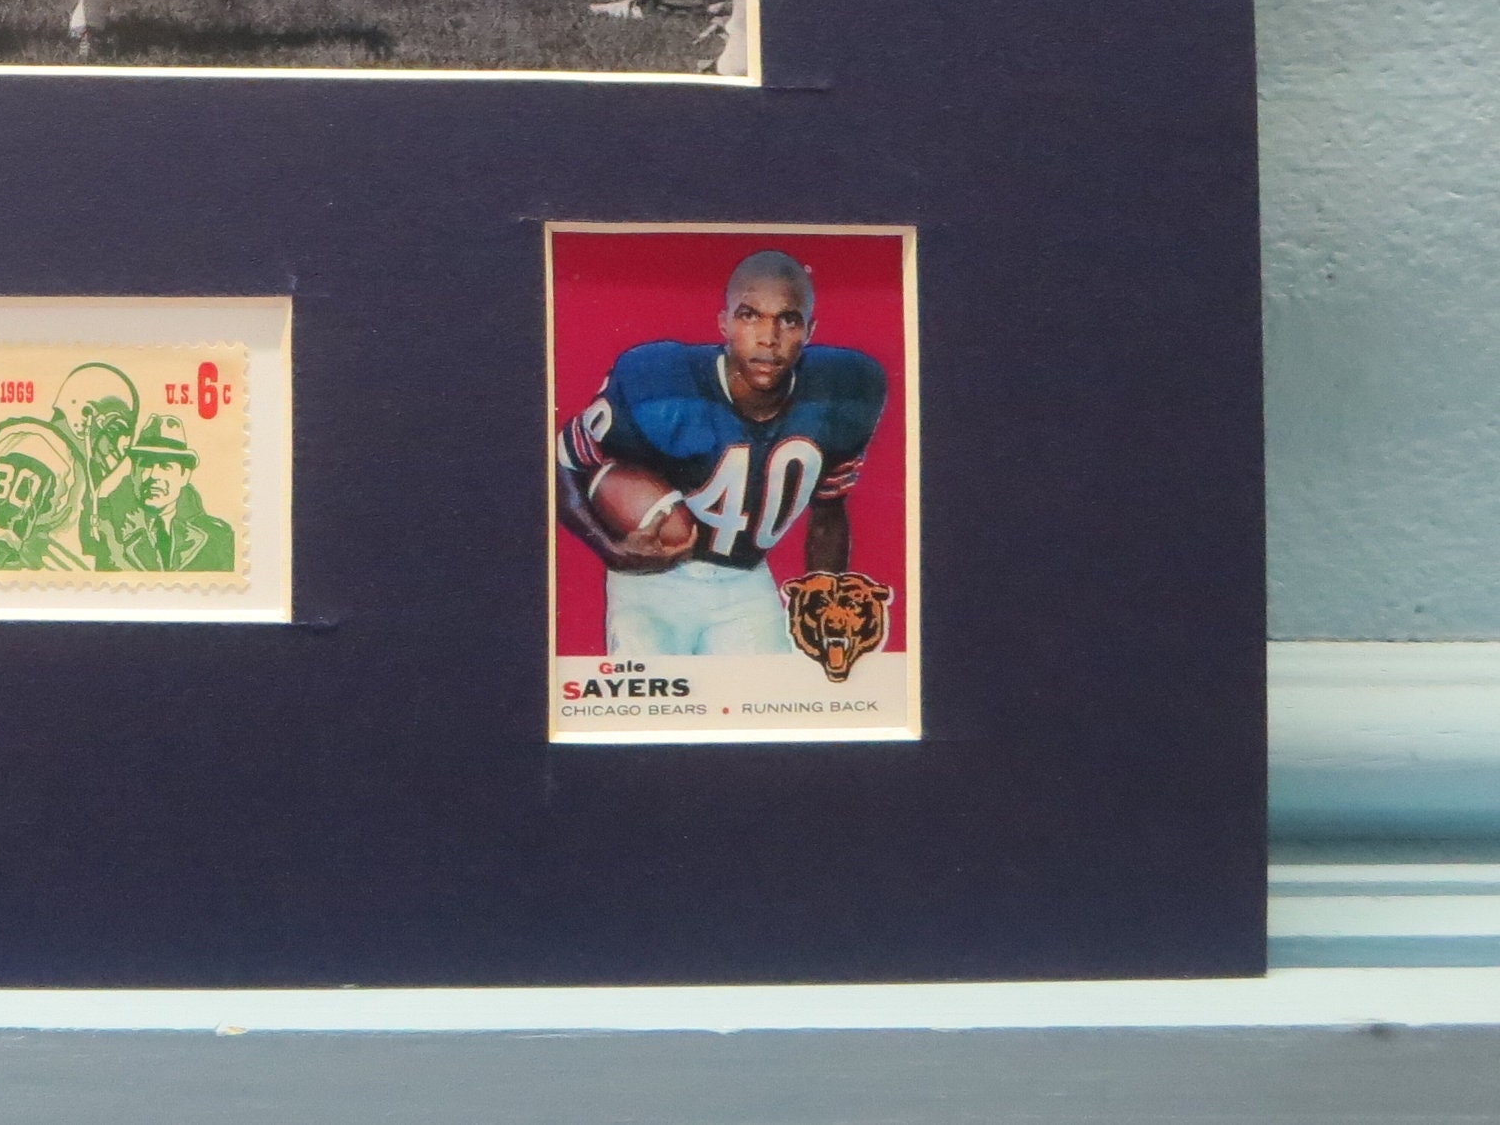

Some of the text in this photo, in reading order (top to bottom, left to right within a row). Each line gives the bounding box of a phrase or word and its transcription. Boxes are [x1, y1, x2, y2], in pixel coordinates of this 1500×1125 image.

[0, 381, 34, 403] 1969
[166, 383, 194, 405] U.S.
[685, 441, 823, 557] 40
[599, 660, 646, 675] Gale
[562, 678, 690, 700] SAYERS
[561, 700, 878, 717] CHICAGO BEARS RUNNING BACK
